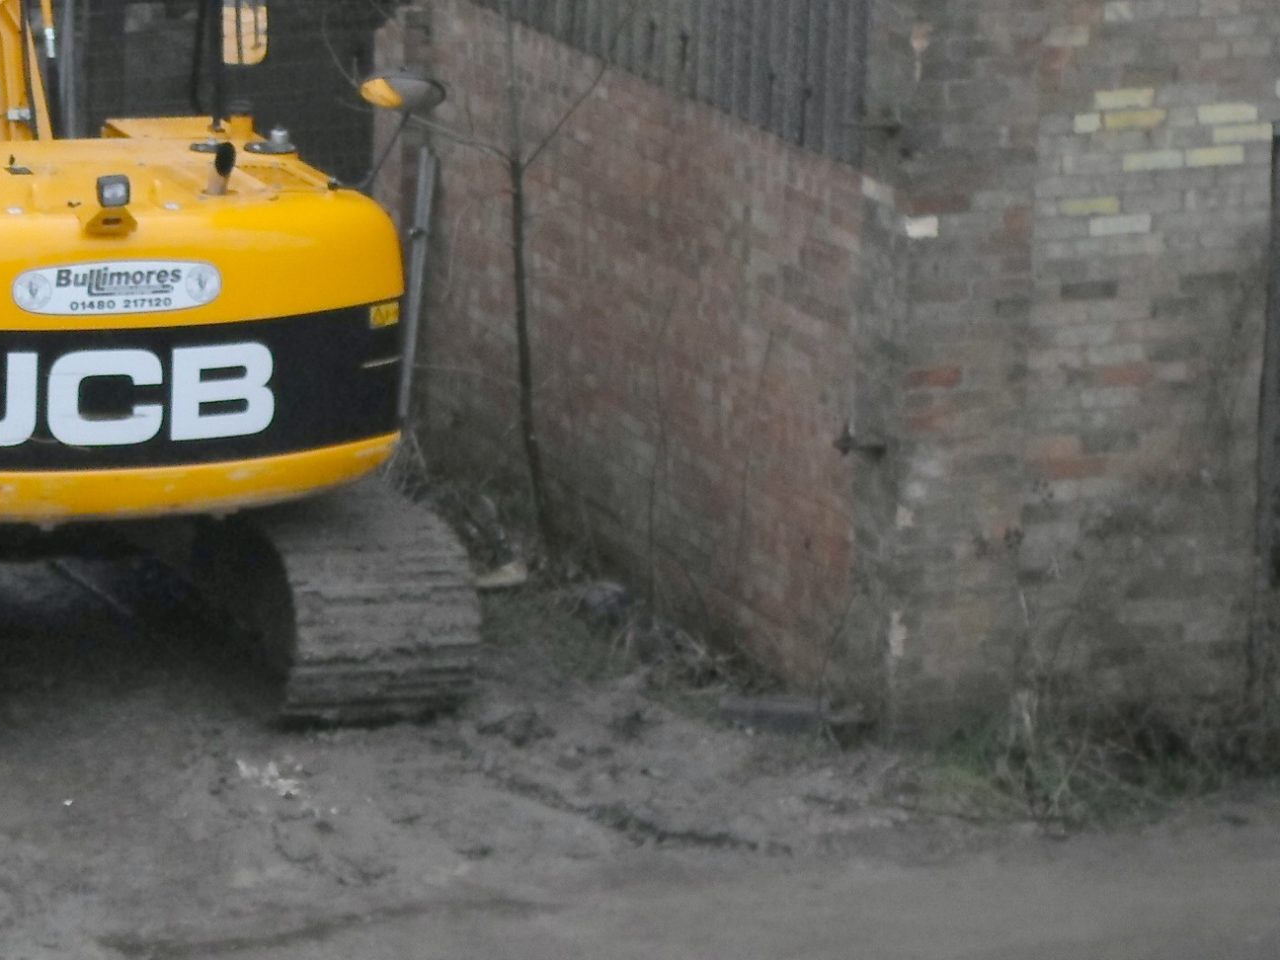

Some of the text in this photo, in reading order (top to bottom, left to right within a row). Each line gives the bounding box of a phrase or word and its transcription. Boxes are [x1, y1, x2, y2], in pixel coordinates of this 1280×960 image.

[56, 267, 182, 296] Bullimores
[70, 297, 173, 311] 01480 217120
